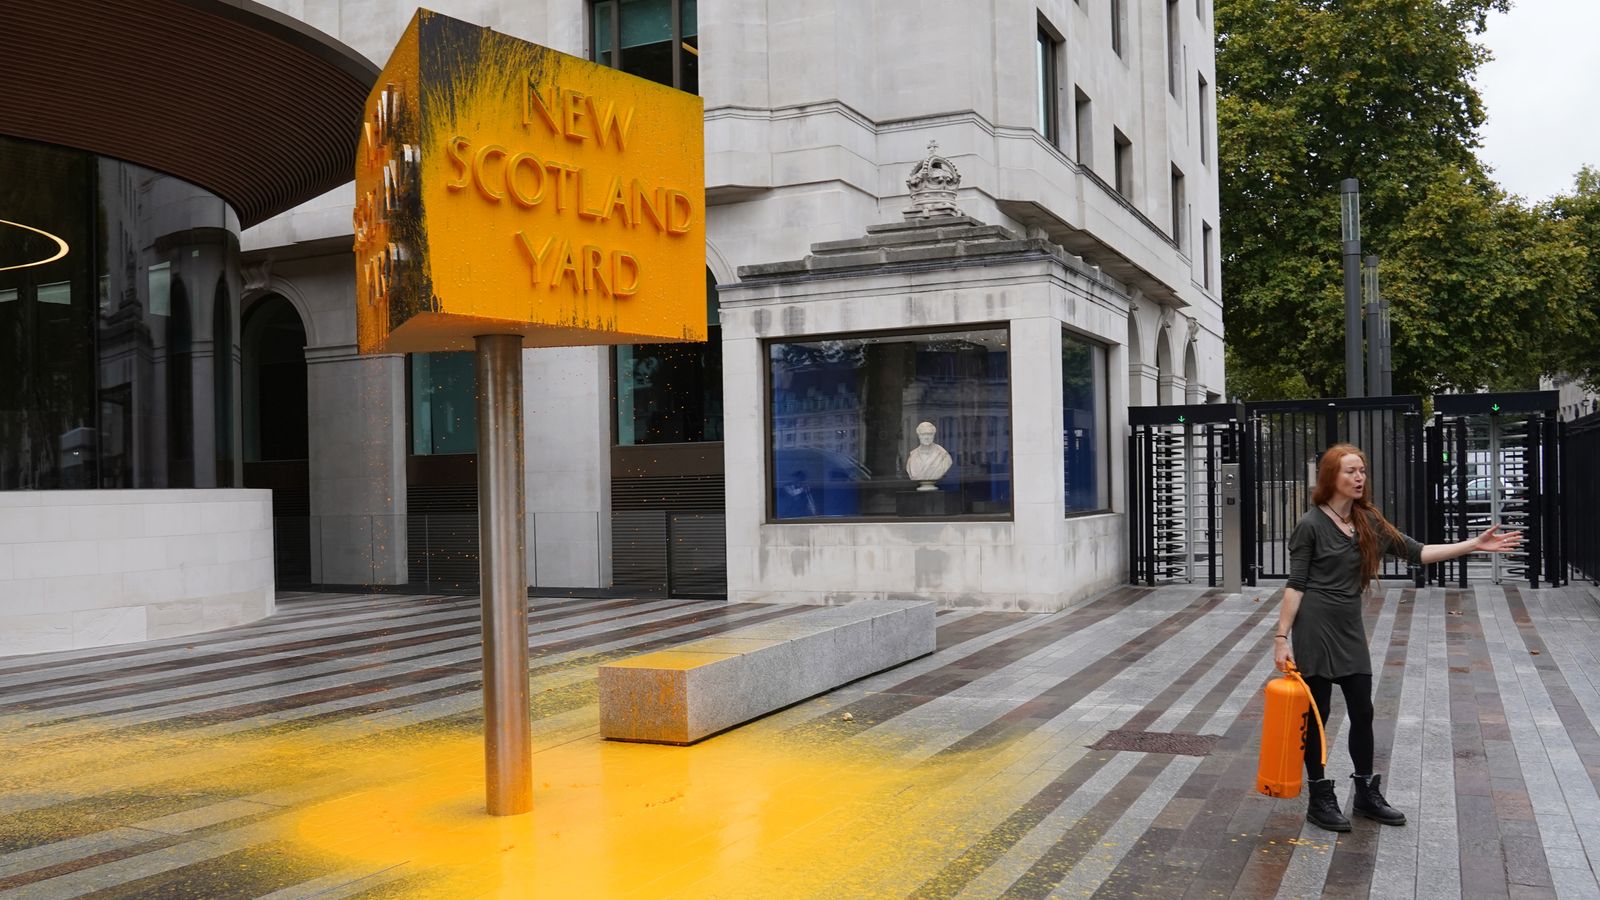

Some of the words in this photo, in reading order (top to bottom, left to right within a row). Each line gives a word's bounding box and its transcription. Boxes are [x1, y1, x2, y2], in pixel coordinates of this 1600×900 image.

[521, 74, 635, 151] NEW
[447, 135, 696, 235] SCOTLAND
[515, 230, 642, 297] YARD
